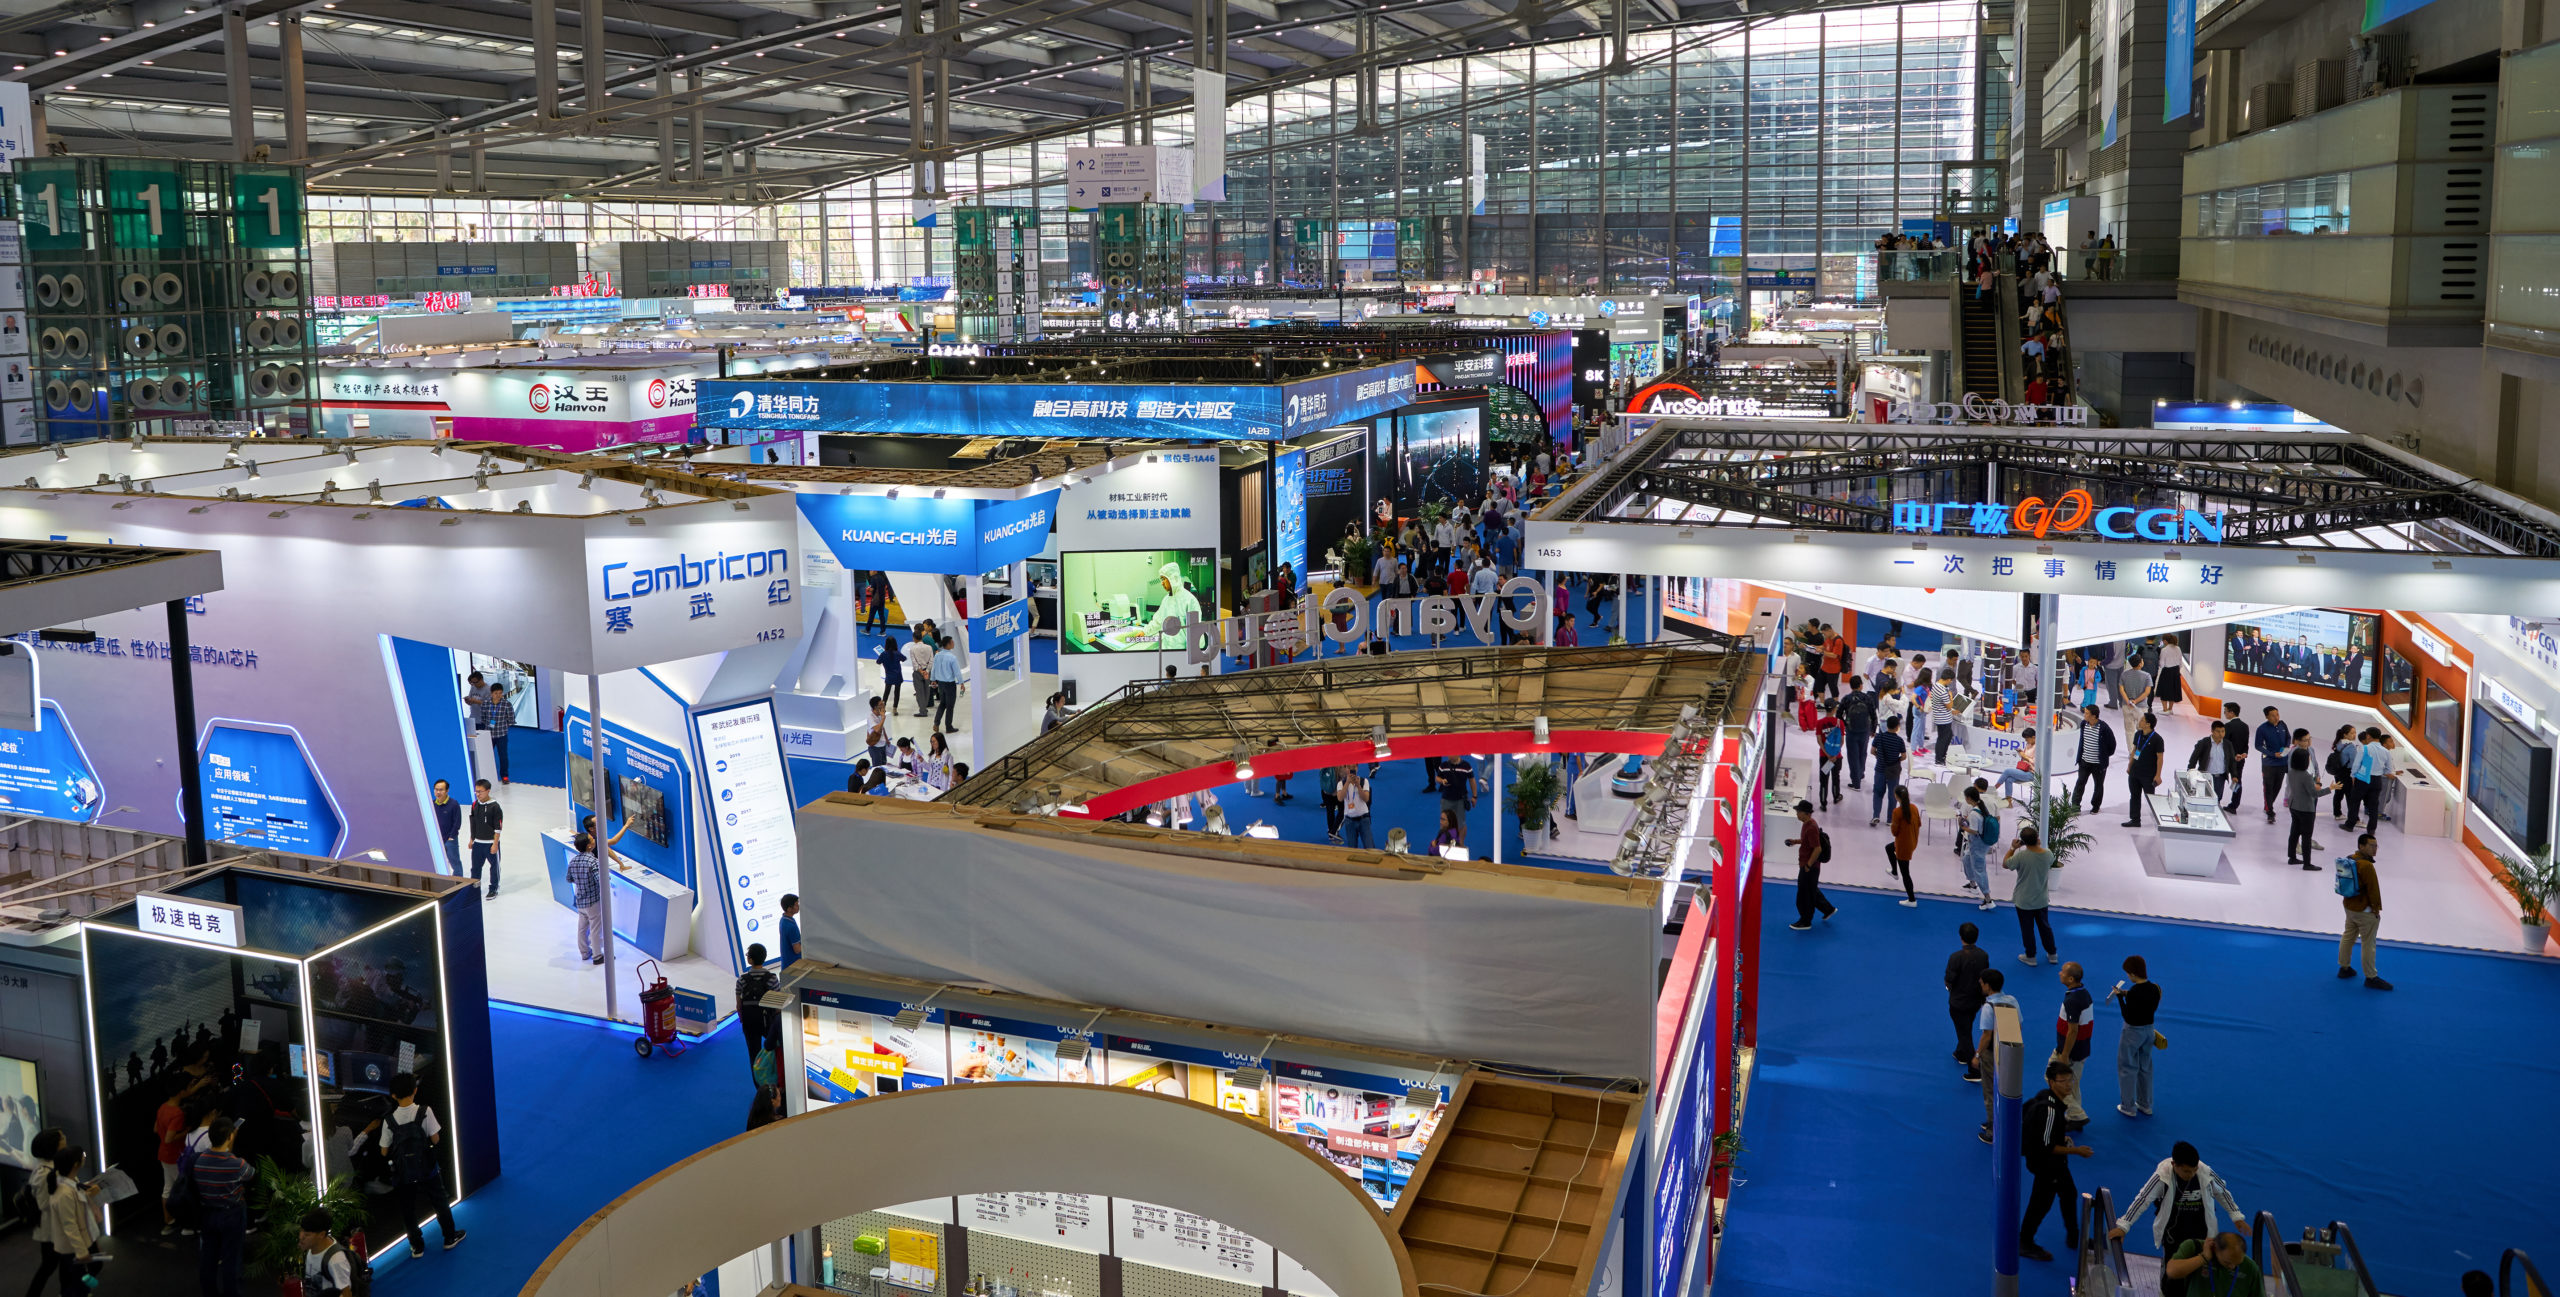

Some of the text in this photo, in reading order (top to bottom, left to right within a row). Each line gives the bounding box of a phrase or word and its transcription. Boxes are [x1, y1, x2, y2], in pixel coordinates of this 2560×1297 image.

[1088, 159, 1096, 170] 2
[38, 183, 59, 236] 1
[137, 184, 163, 236] 1
[258, 186, 281, 236] 1
[966, 217, 975, 239] 1
[1114, 213, 1125, 237] 1
[1151, 213, 1157, 235] 1
[1173, 214, 1180, 236] 1
[1303, 224, 1311, 239] 1
[1407, 222, 1414, 238] 1
[1454, 357, 1494, 372] 平安科技
[1585, 370, 1604, 381] 8K
[554, 384, 608, 402] 汉王
[1356, 379, 1386, 401] 融合高科技
[554, 402, 606, 413] Hanvon
[669, 397, 696, 408] Hanv
[757, 394, 819, 413] 清华同方
[1033, 400, 1236, 419] 融合高科技 智造大湾区
[1300, 391, 1327, 416] 清华同方
[1649, 393, 1723, 415] ArcSoft
[1109, 492, 1168, 502] 材料工业新时代
[1087, 507, 1192, 520] 从被动选择到主动赋能
[1893, 500, 2223, 542] 中广核 CGN
[984, 509, 1046, 544] KUANG-CHI光启
[842, 528, 957, 547] KUANG-CHI光启
[1537, 548, 1562, 558] 1A53
[602, 548, 788, 600] Cambricon
[1893, 553, 2223, 585] 一次把事情做好
[605, 578, 792, 634] 寒武纪
[757, 628, 785, 643] 1A52
[2538, 632, 2558, 655] CGN
[711, 713, 760, 731] 寒武纪发展历程
[214, 767, 251, 783] 应用领域
[152, 905, 221, 934] 极速电竞
[1335, 1136, 1389, 1153] 制造部件管理
